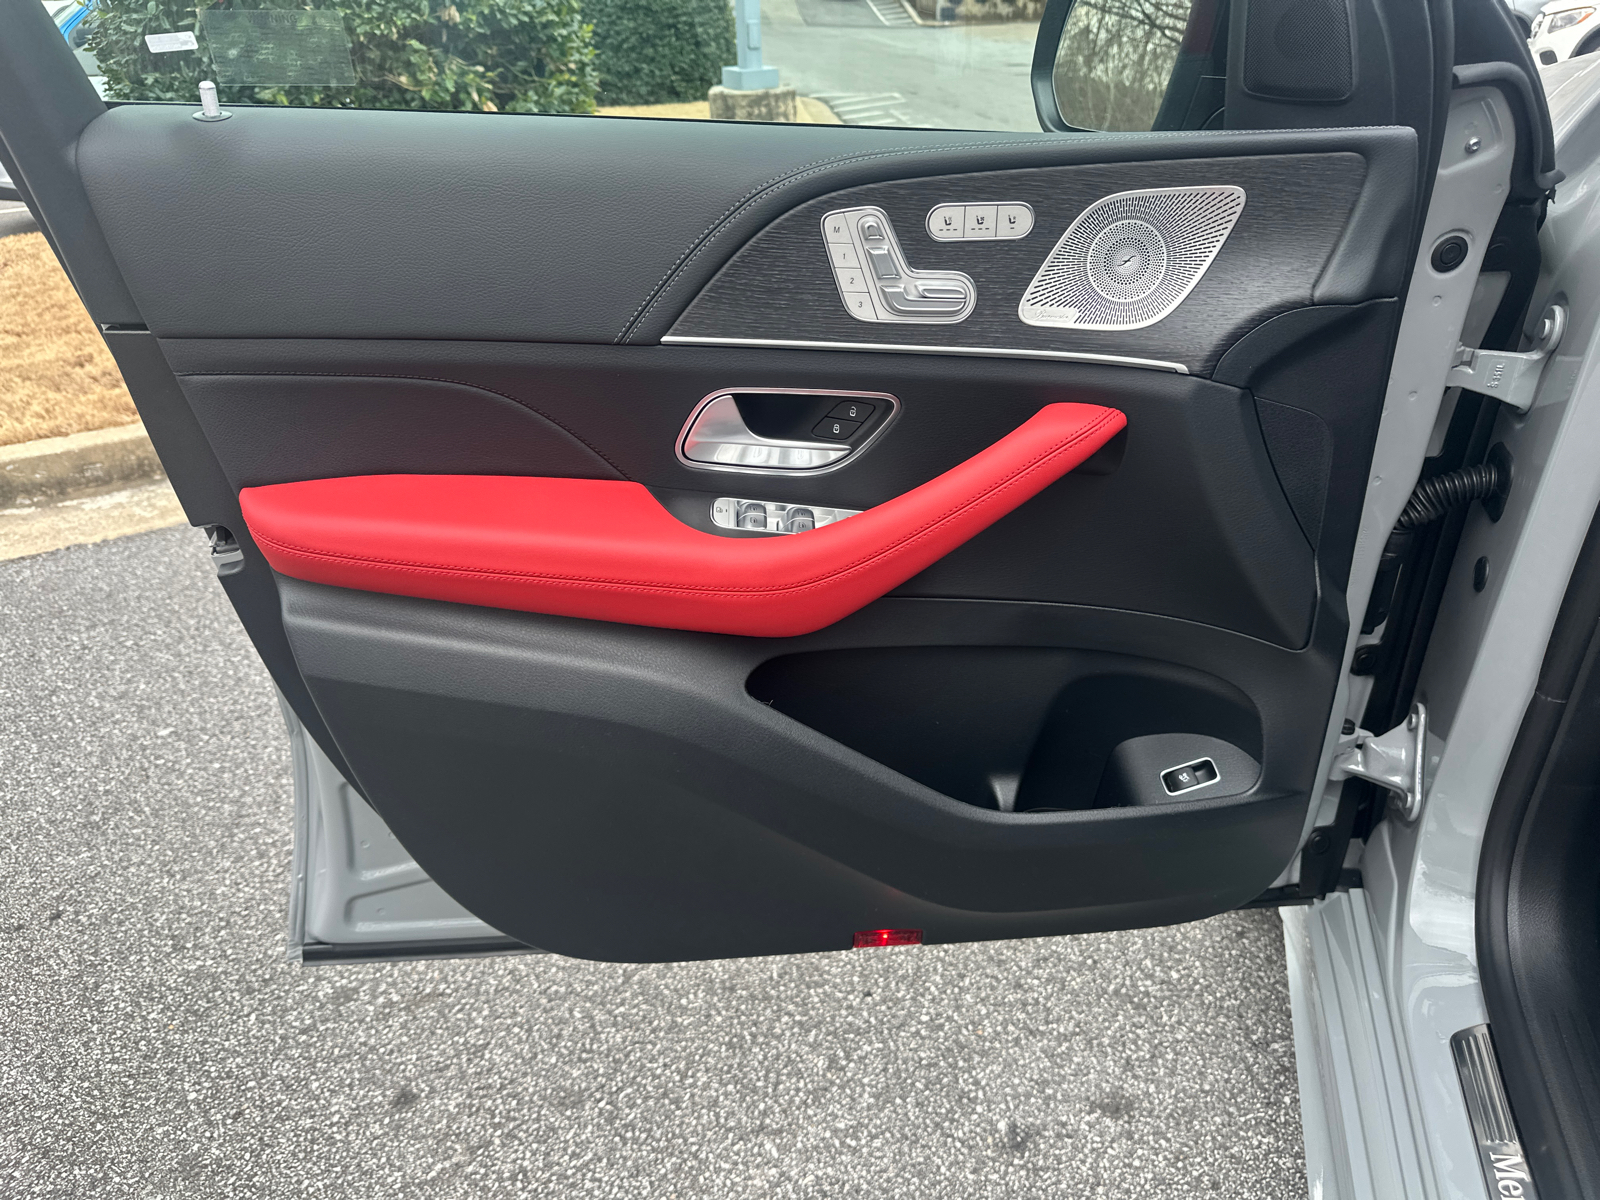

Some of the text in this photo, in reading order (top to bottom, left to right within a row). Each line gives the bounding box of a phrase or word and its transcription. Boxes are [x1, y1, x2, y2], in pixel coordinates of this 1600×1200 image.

[247, 13, 298, 25] WNING
[850, 277, 855, 285] 2
[858, 301, 863, 309] 3
